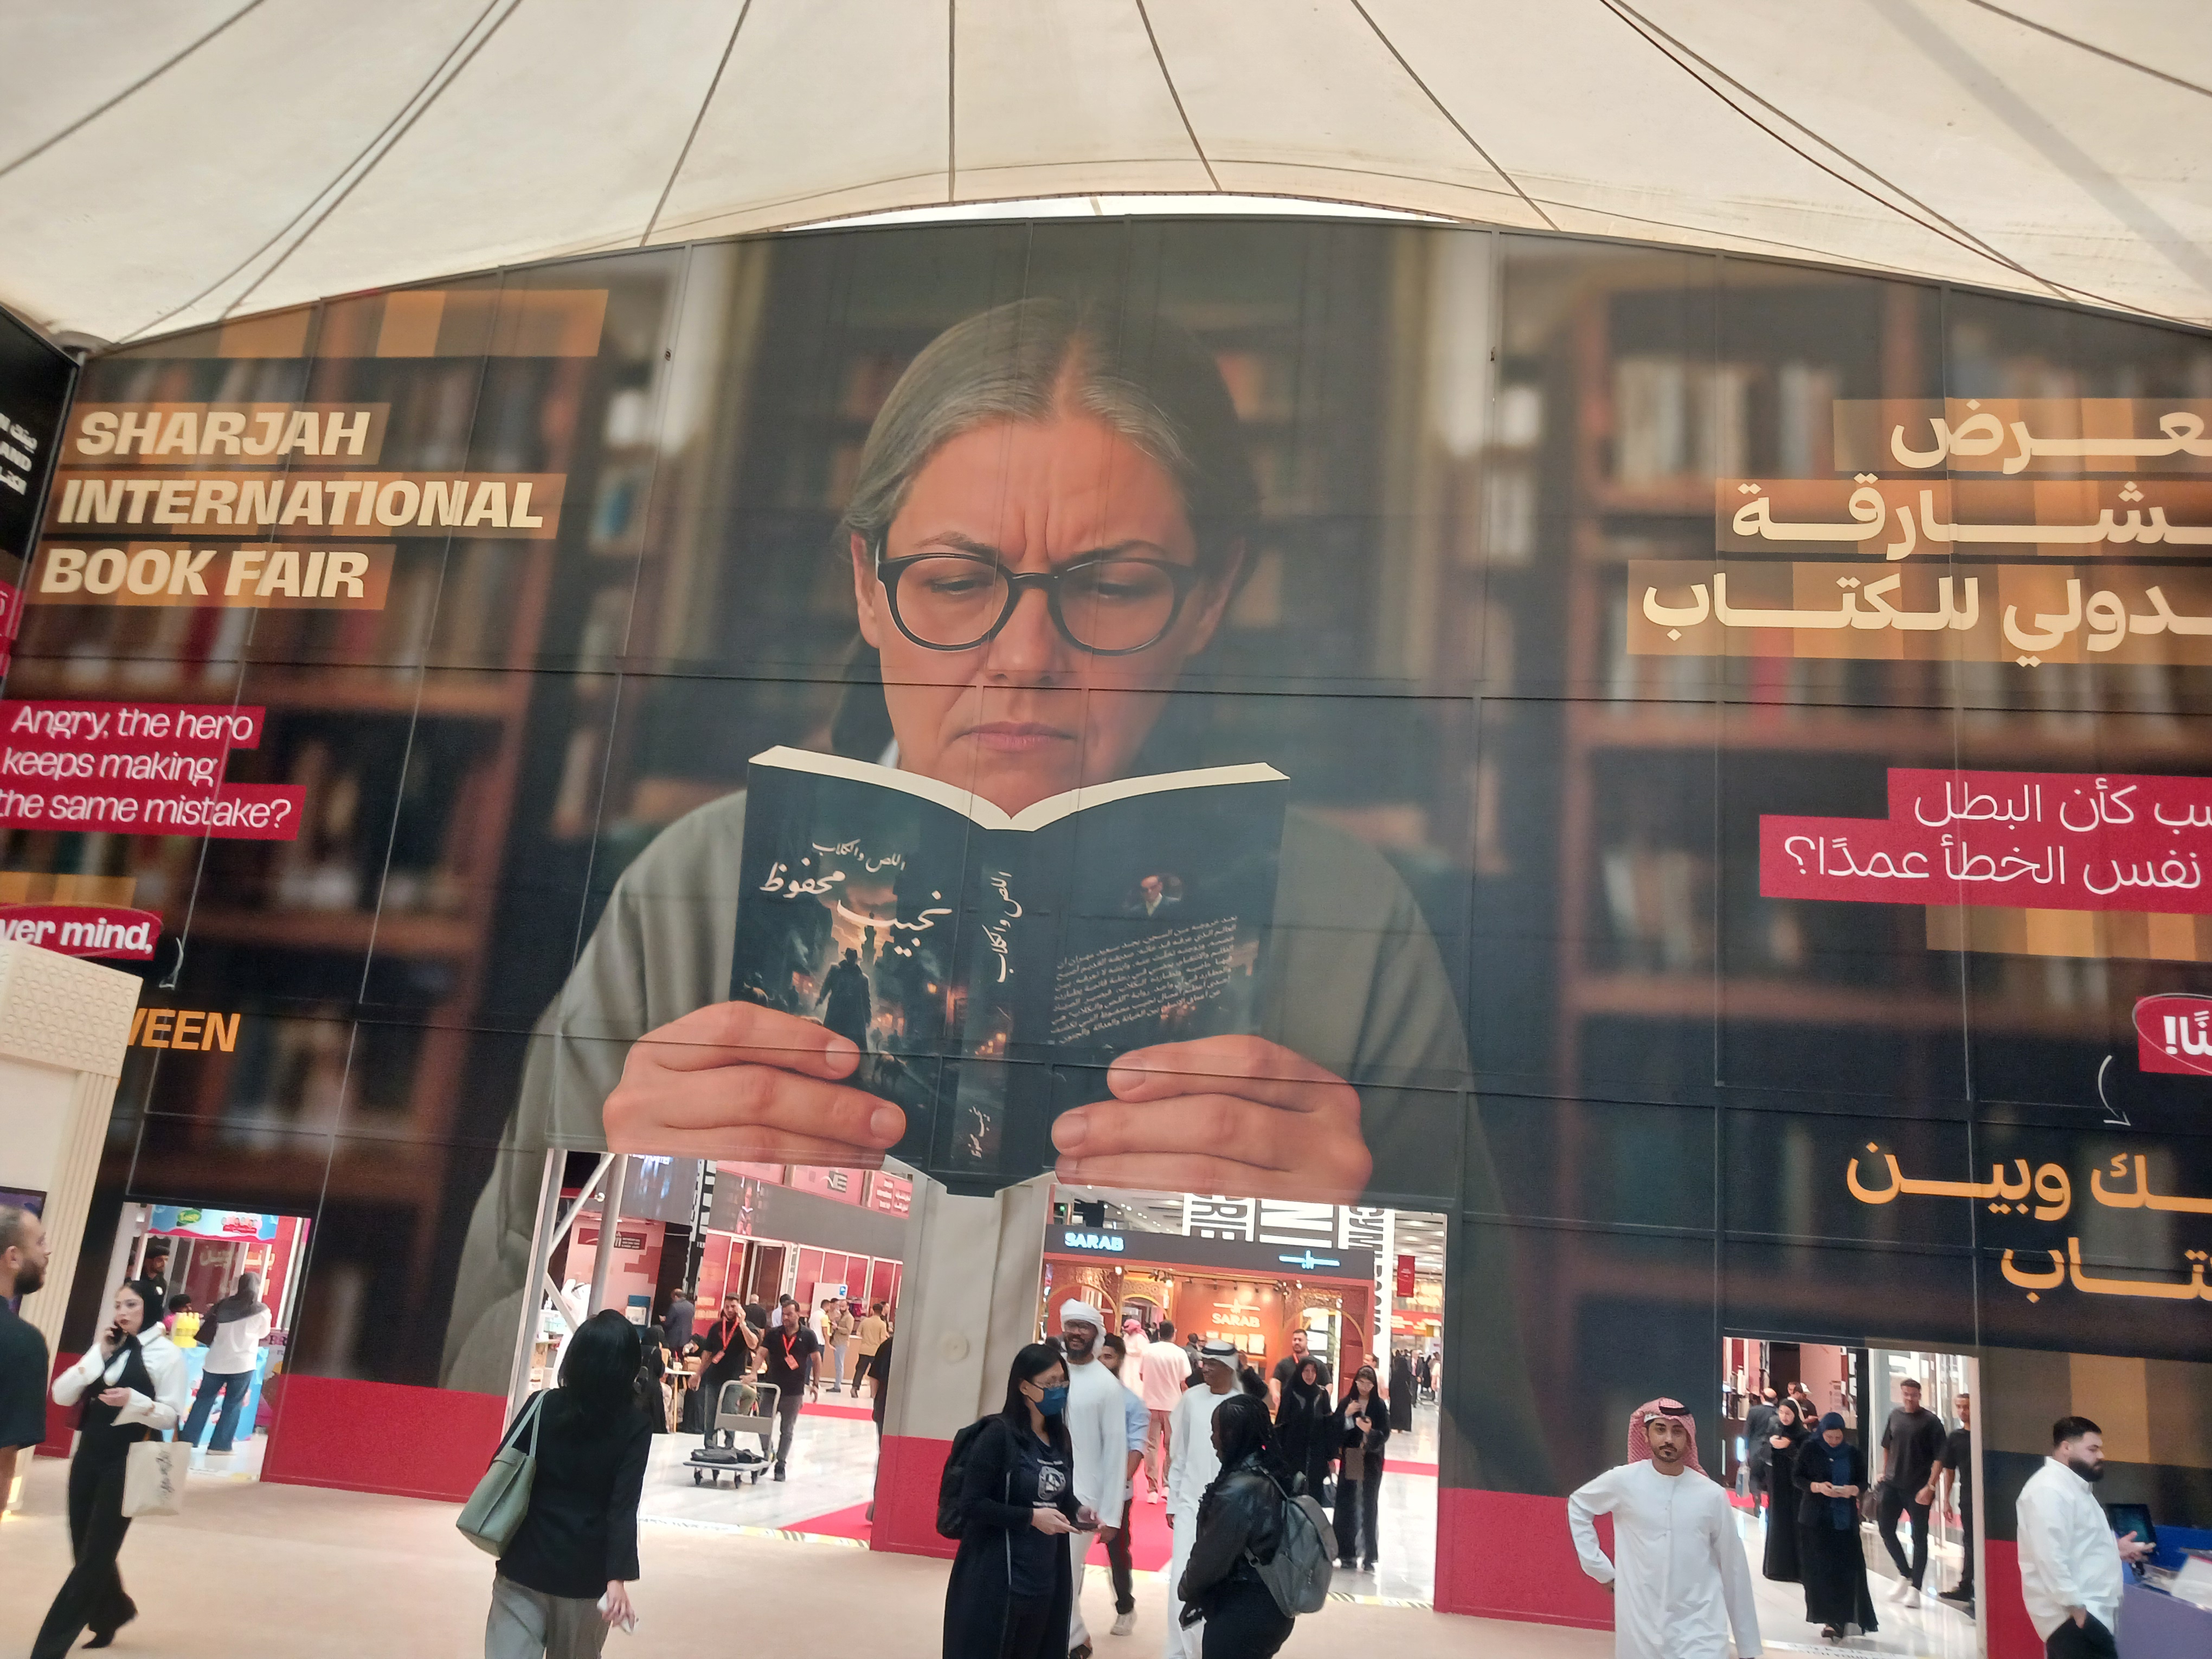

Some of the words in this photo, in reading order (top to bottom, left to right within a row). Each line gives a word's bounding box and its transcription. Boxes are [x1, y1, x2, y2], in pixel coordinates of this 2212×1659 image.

[77, 411, 371, 455] SHARJAH
[57, 479, 543, 528] INTERNATIONAL
[40, 548, 217, 596] BOOK
[224, 551, 370, 597] FAIR
[1642, 572, 1979, 641] للكتاب
[11, 706, 111, 740] Angry,
[118, 708, 170, 738] the
[177, 710, 254, 741] hero
[2, 747, 95, 781] keeps
[100, 751, 218, 787] making
[0, 789, 45, 819] the
[48, 795, 138, 822] same
[144, 795, 292, 828] mistake?
[1914, 781, 2042, 831] البطل
[2060, 777, 2138, 832] كأن
[759, 857, 846, 898] محفوظ
[1940, 833, 2066, 885] الخطأ
[2083, 849, 2202, 895] نفس
[1846, 1141, 2072, 1221] وبين
[1064, 1232, 1124, 1251] SARAB
[2001, 1237, 2212, 1303] تاب
[1212, 1313, 1261, 1328] SARAB
